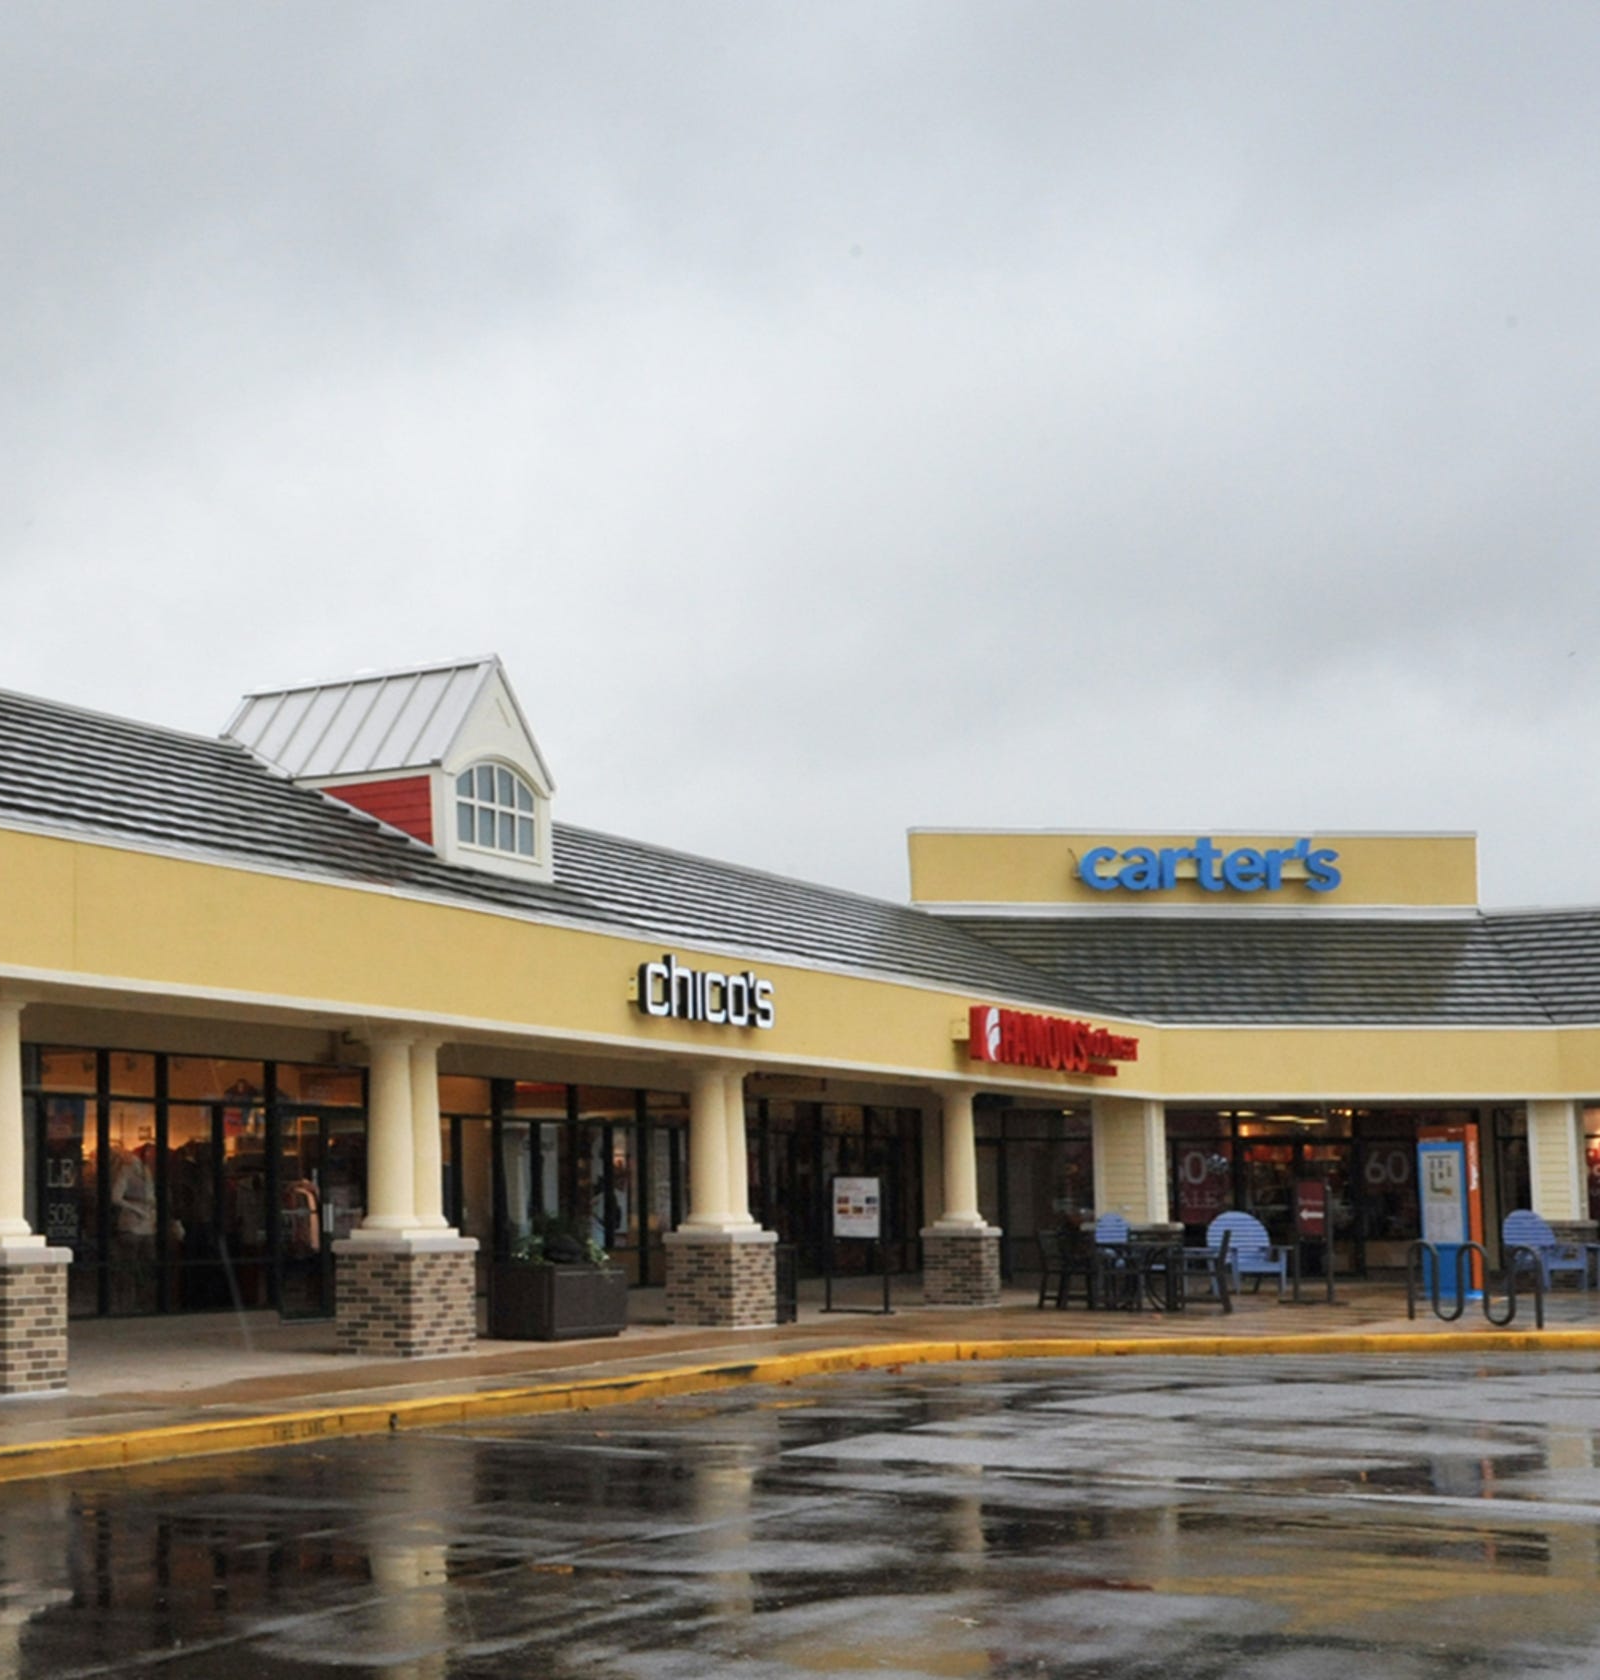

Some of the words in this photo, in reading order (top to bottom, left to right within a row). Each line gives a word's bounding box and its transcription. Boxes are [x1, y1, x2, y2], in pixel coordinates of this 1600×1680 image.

[1078, 837, 1342, 892] carter's
[638, 953, 775, 1030] chico's
[1364, 1150, 1410, 1185] 60
[47, 1202, 79, 1226] 50%
